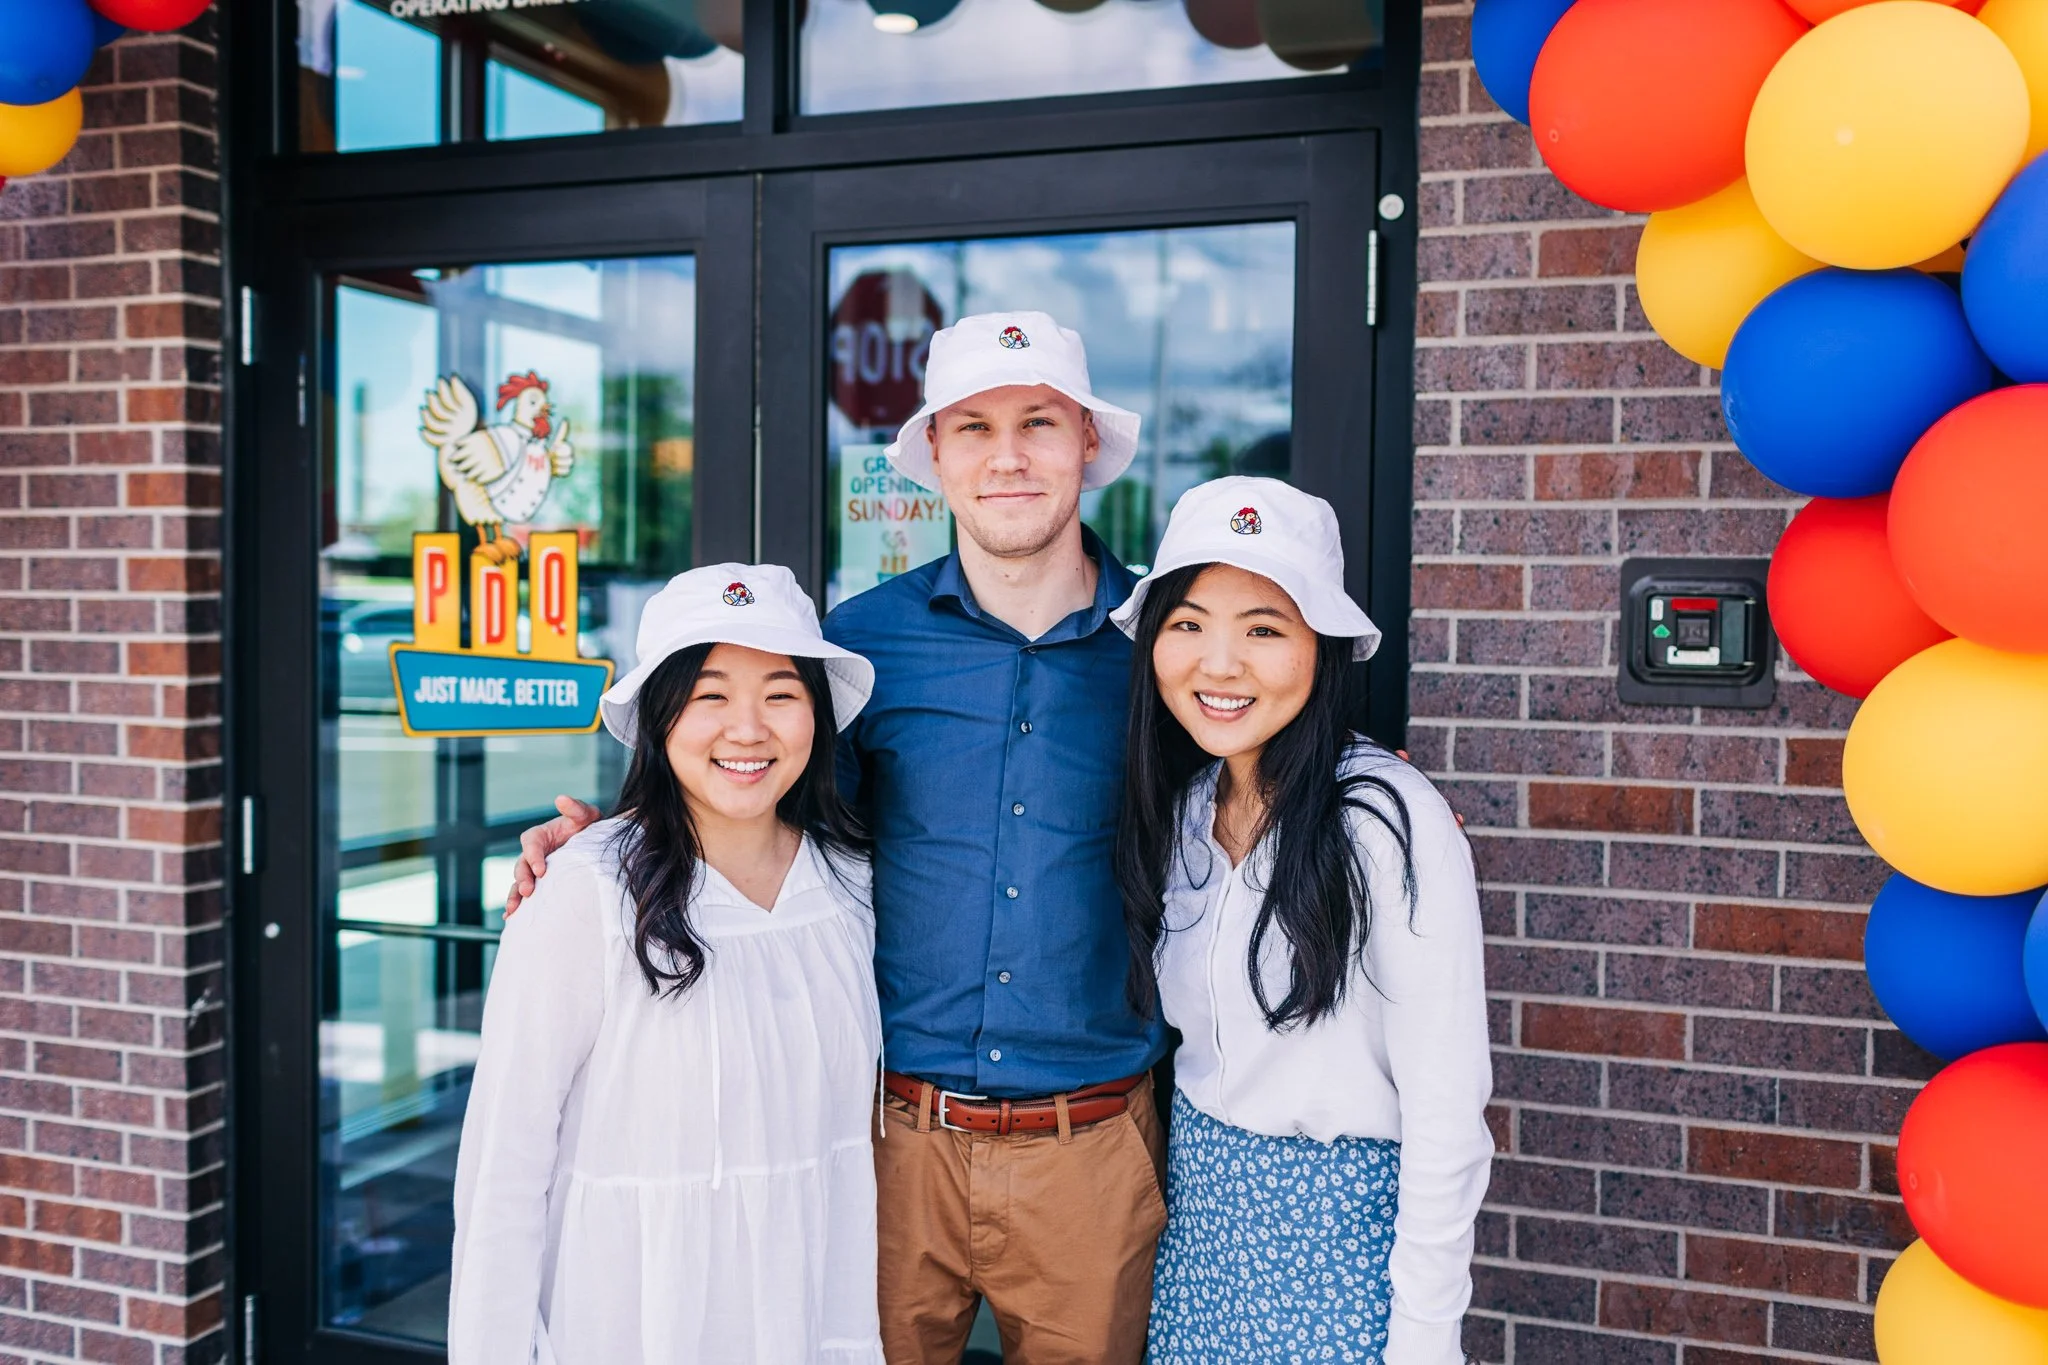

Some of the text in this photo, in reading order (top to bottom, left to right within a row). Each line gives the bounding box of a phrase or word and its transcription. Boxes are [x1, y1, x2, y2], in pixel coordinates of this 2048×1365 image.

[851, 476, 932, 493] OPENIN
[848, 499, 944, 521] SUNDAY!
[422, 547, 567, 646] PDQ
[414, 676, 578, 706] JUST MADE, BETTER
